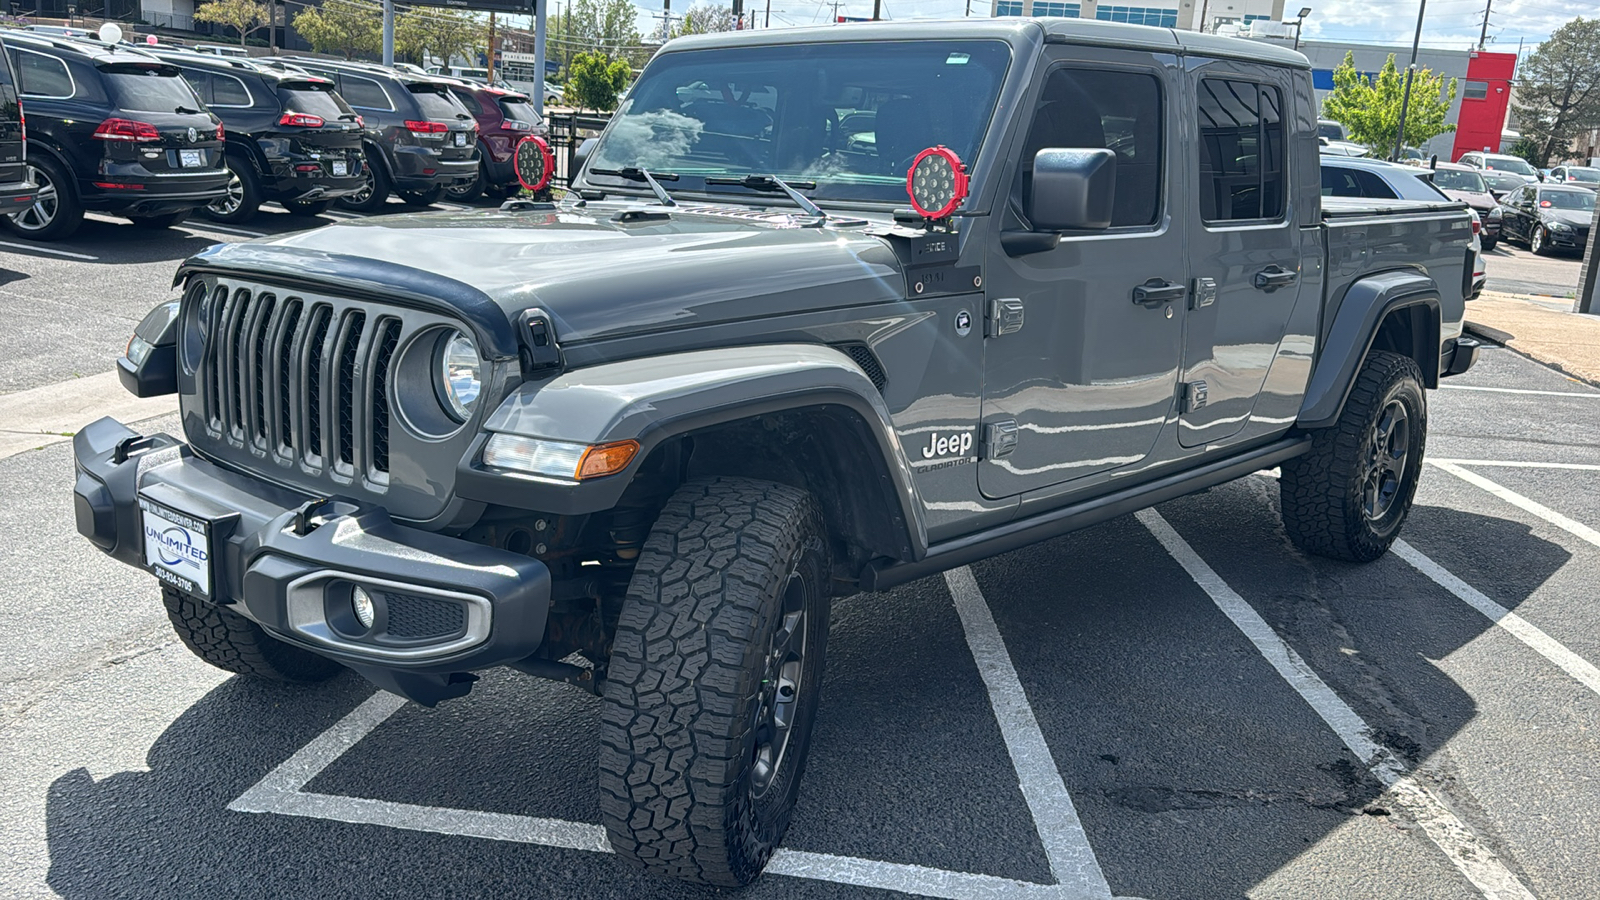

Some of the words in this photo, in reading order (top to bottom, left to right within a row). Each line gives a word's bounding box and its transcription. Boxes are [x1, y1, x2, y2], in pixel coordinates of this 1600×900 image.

[922, 431, 972, 459] Jeep
[917, 457, 972, 474] GLADIATOR
[146, 525, 208, 562] UNLIMITED
